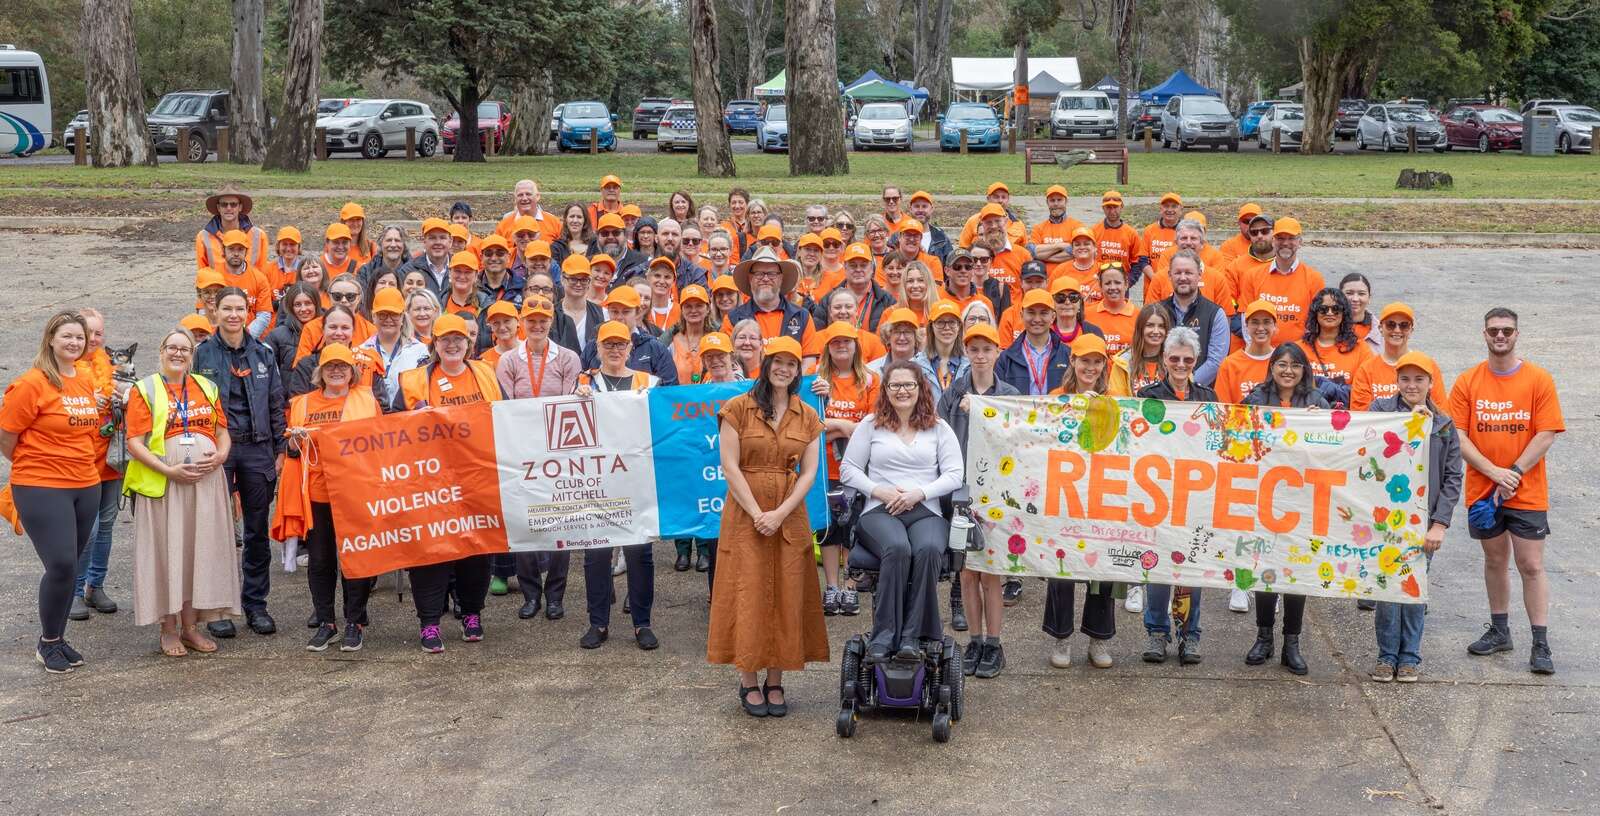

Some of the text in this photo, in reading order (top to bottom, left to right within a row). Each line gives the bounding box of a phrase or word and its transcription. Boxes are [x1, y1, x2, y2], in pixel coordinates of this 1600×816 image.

[1101, 240, 1121, 248] Steps
[1260, 293, 1289, 303] Steps
[1372, 383, 1400, 394] Step
[62, 396, 90, 407] Steps
[829, 400, 856, 411] teps
[1476, 400, 1513, 411] Steps
[63, 406, 98, 416] Towar
[308, 411, 338, 421] ZONTA
[1476, 410, 1531, 421] Towards
[1477, 422, 1529, 434] Change.
[339, 422, 471, 456] ZONTA SAYS
[381, 458, 440, 482] NO TO
[522, 453, 628, 481] ZONTA
[555, 477, 602, 490] CLUB OF
[552, 489, 608, 502] MITCHELL
[1044, 449, 1347, 536] RESPECT
[366, 486, 463, 517] VIOLENCE
[528, 510, 632, 527] EMPOWERING WOMEN
[529, 526, 562, 534] THROUGH
[563, 524, 588, 532] SERVICE
[596, 519, 633, 529] ADVOCACY
[341, 515, 500, 554] AGAINST WOMEN
[566, 540, 593, 548] Bendigo
[593, 538, 610, 546] Bank
[1327, 543, 1384, 561] RESPECT
